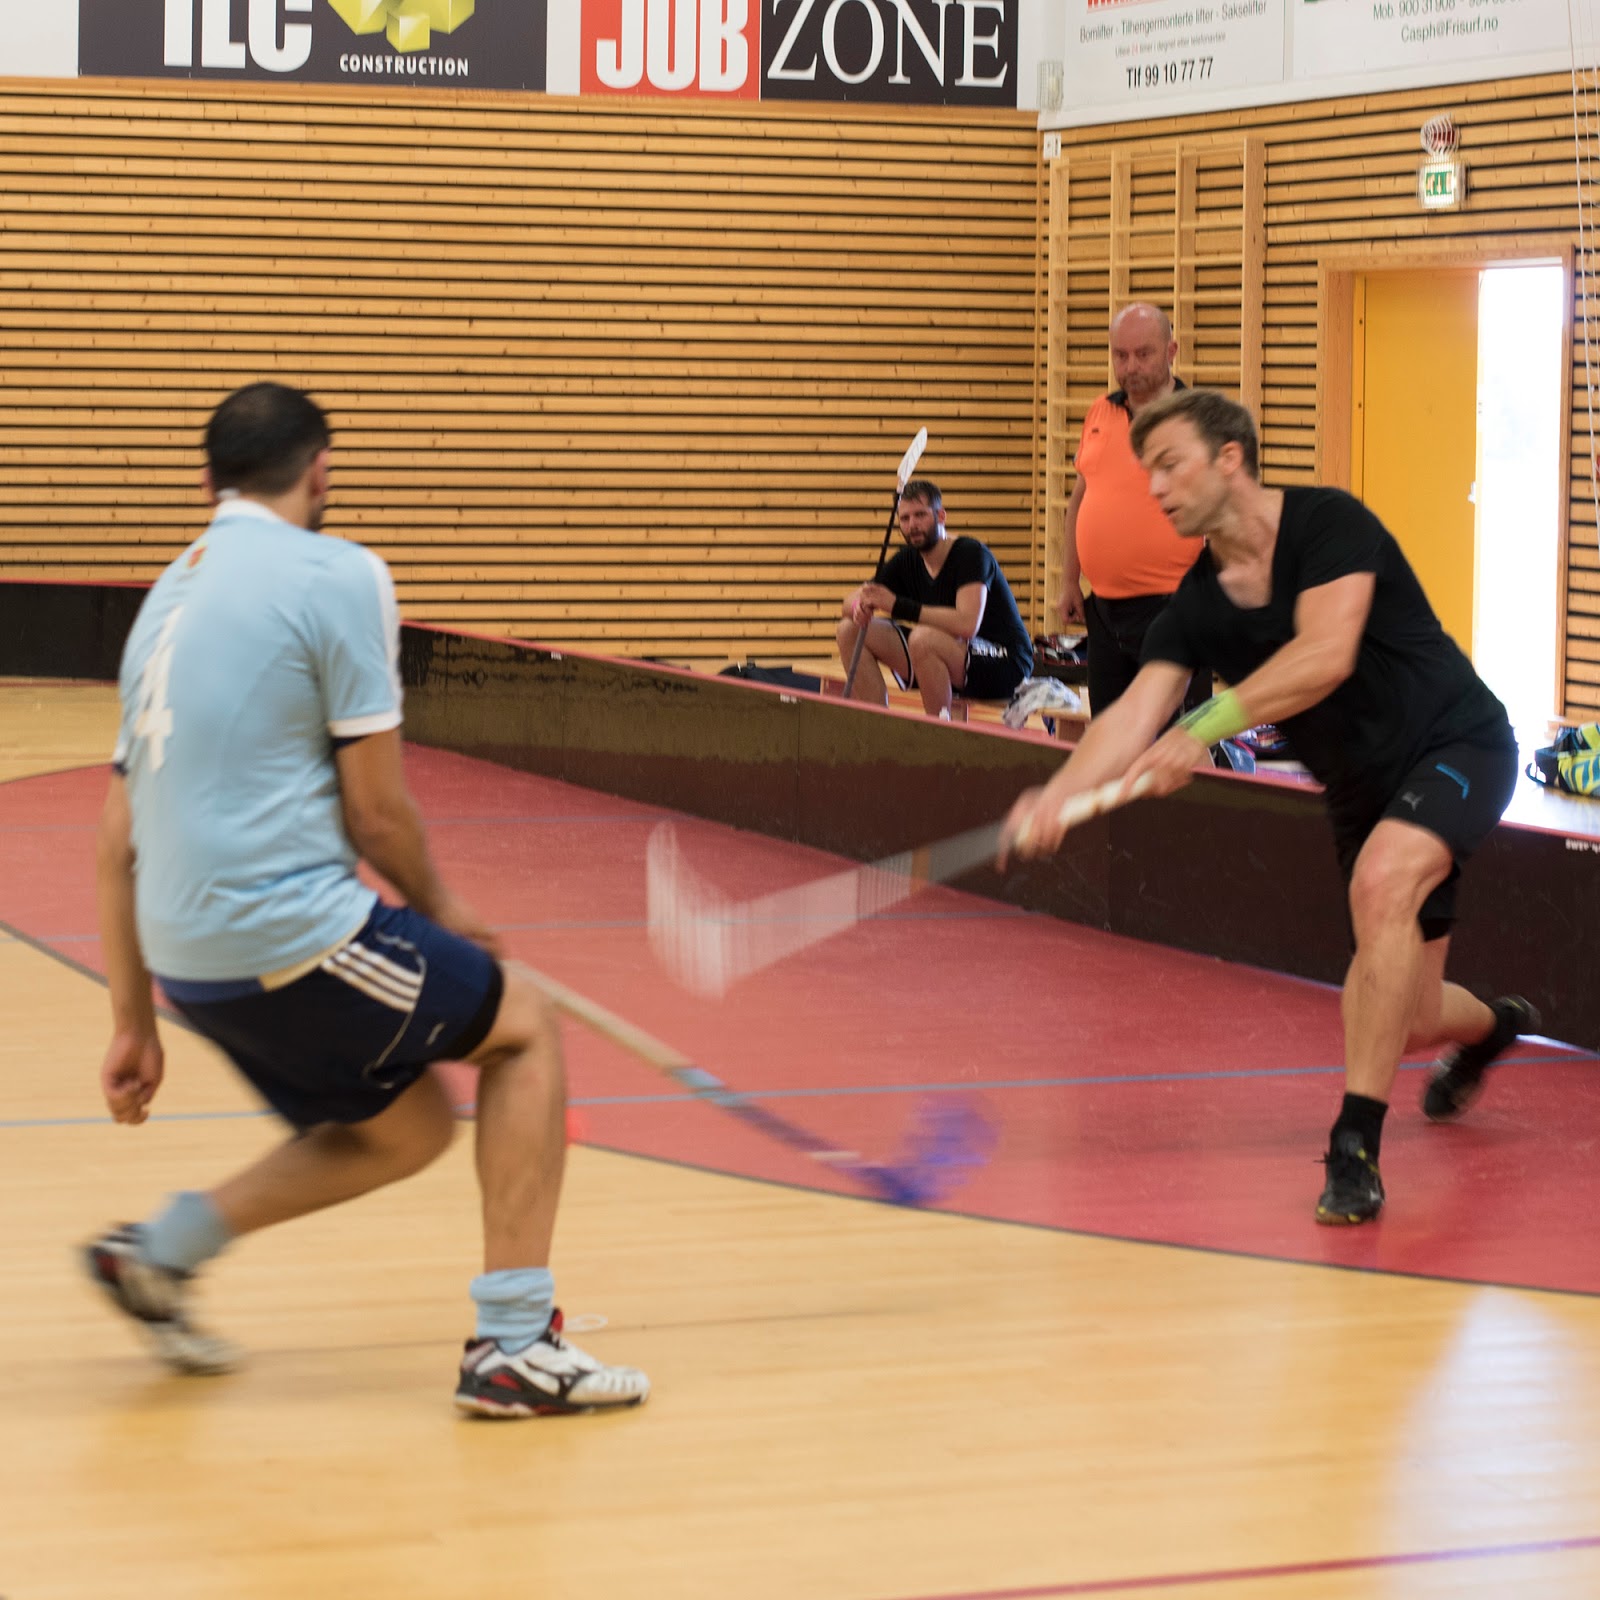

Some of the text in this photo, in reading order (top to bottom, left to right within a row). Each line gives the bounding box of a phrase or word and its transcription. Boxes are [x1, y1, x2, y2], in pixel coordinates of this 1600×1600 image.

[1195, 9, 1214, 25] lifter
[596, 0, 1009, 91] JOB ZONE
[339, 53, 470, 77] CONSTRUCTION
[1126, 56, 1214, 88] Tlf 99 10 77 77
